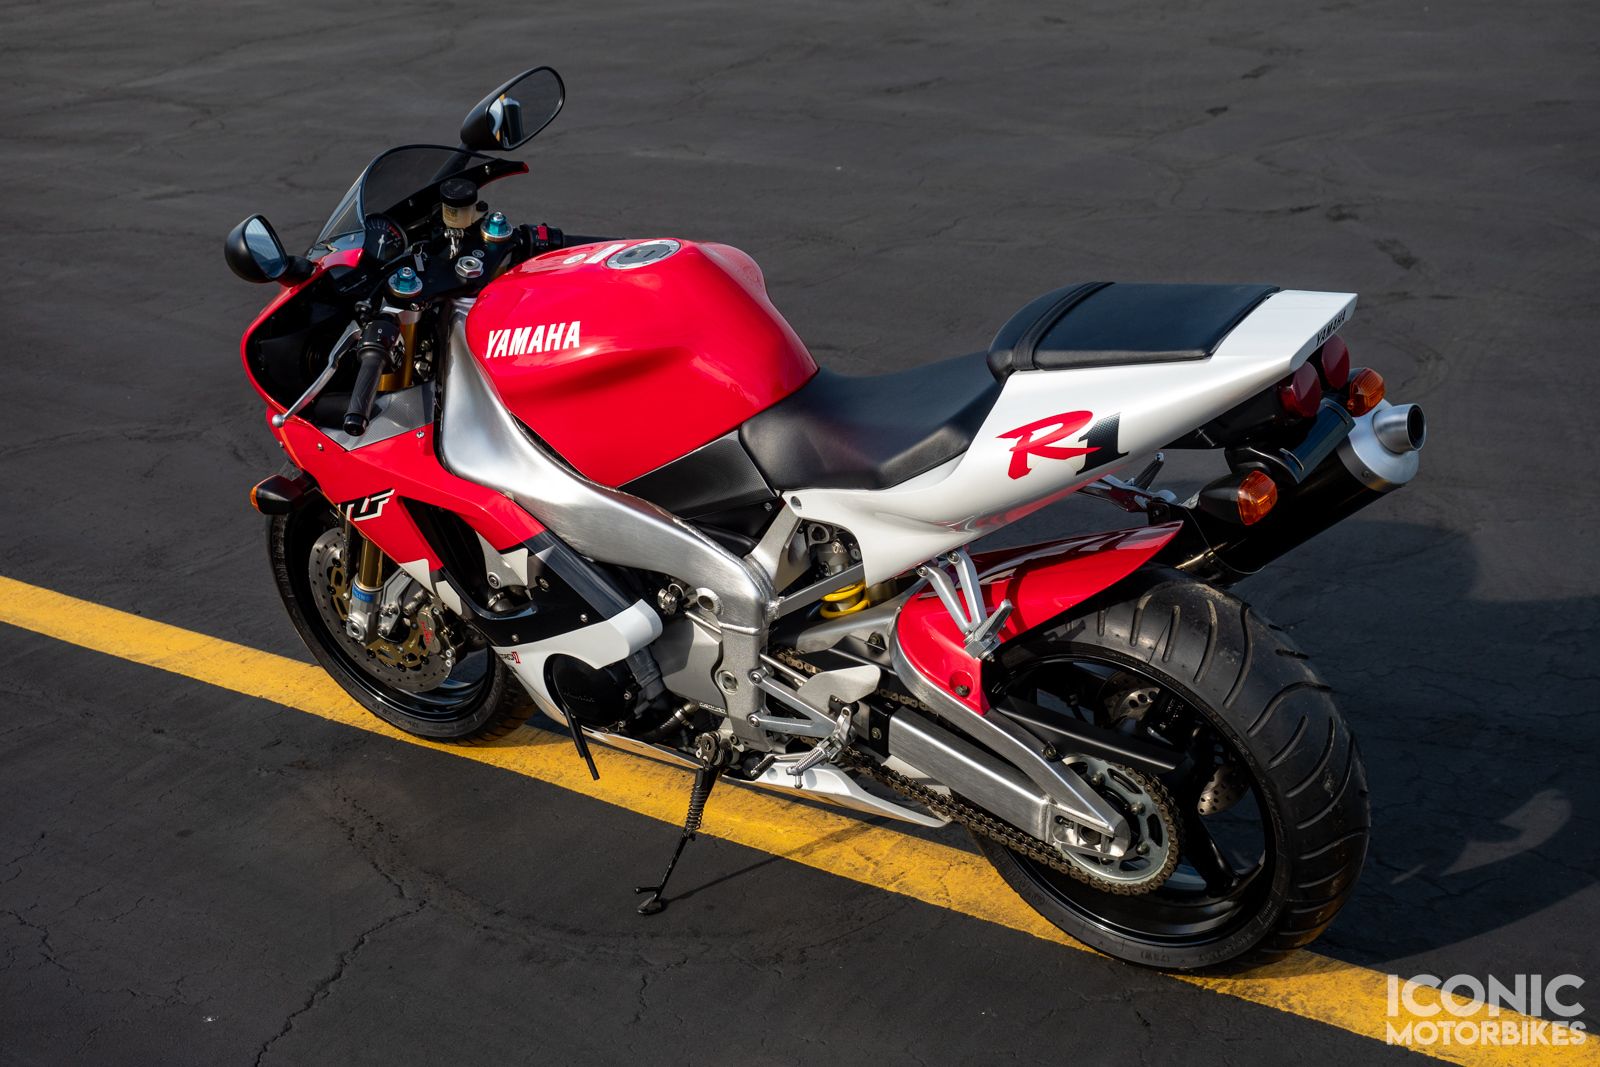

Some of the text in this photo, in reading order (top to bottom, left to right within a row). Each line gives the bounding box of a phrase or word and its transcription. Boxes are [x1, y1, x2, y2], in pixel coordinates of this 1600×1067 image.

[485, 320, 581, 359] YAMAHA
[1315, 308, 1346, 347] YAMAHA
[995, 410, 1129, 480] R1
